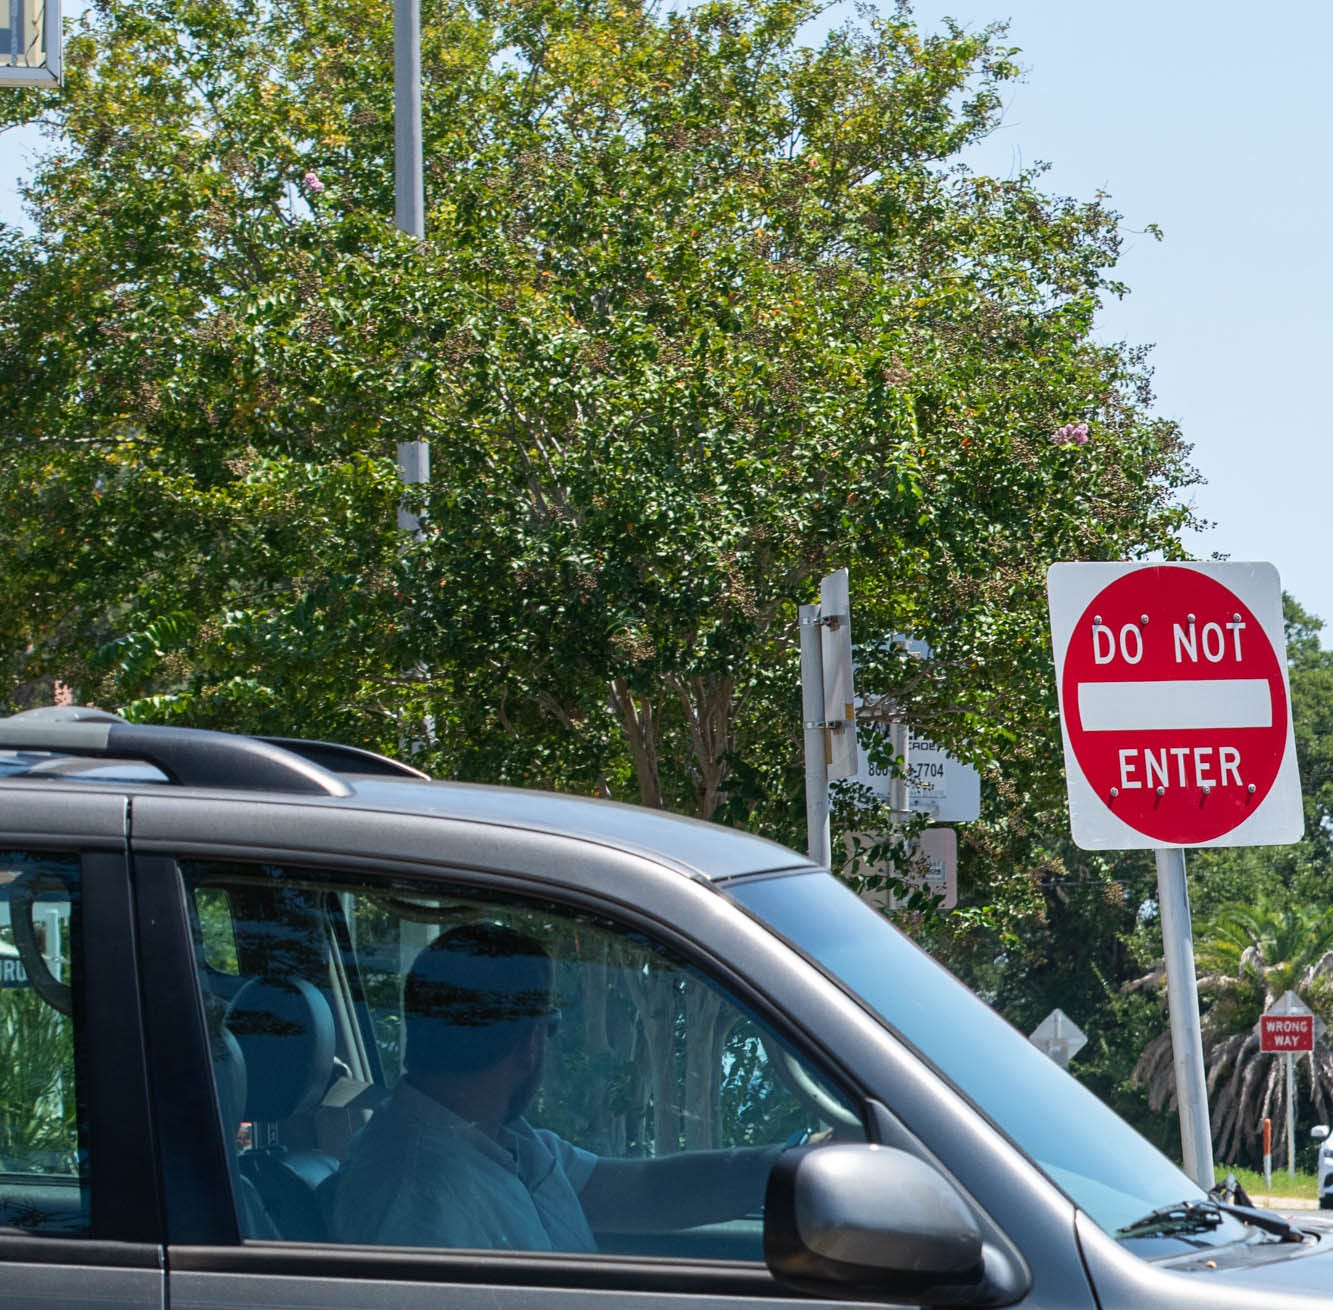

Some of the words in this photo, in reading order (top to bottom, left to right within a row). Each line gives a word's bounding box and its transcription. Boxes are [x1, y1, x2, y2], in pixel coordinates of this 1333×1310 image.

[1091, 623, 1144, 664] DO
[1173, 622, 1246, 663] NOT
[1118, 746, 1243, 789] ENTER
[1266, 1021, 1308, 1033] WRONG
[1274, 1035, 1300, 1047] WAY
